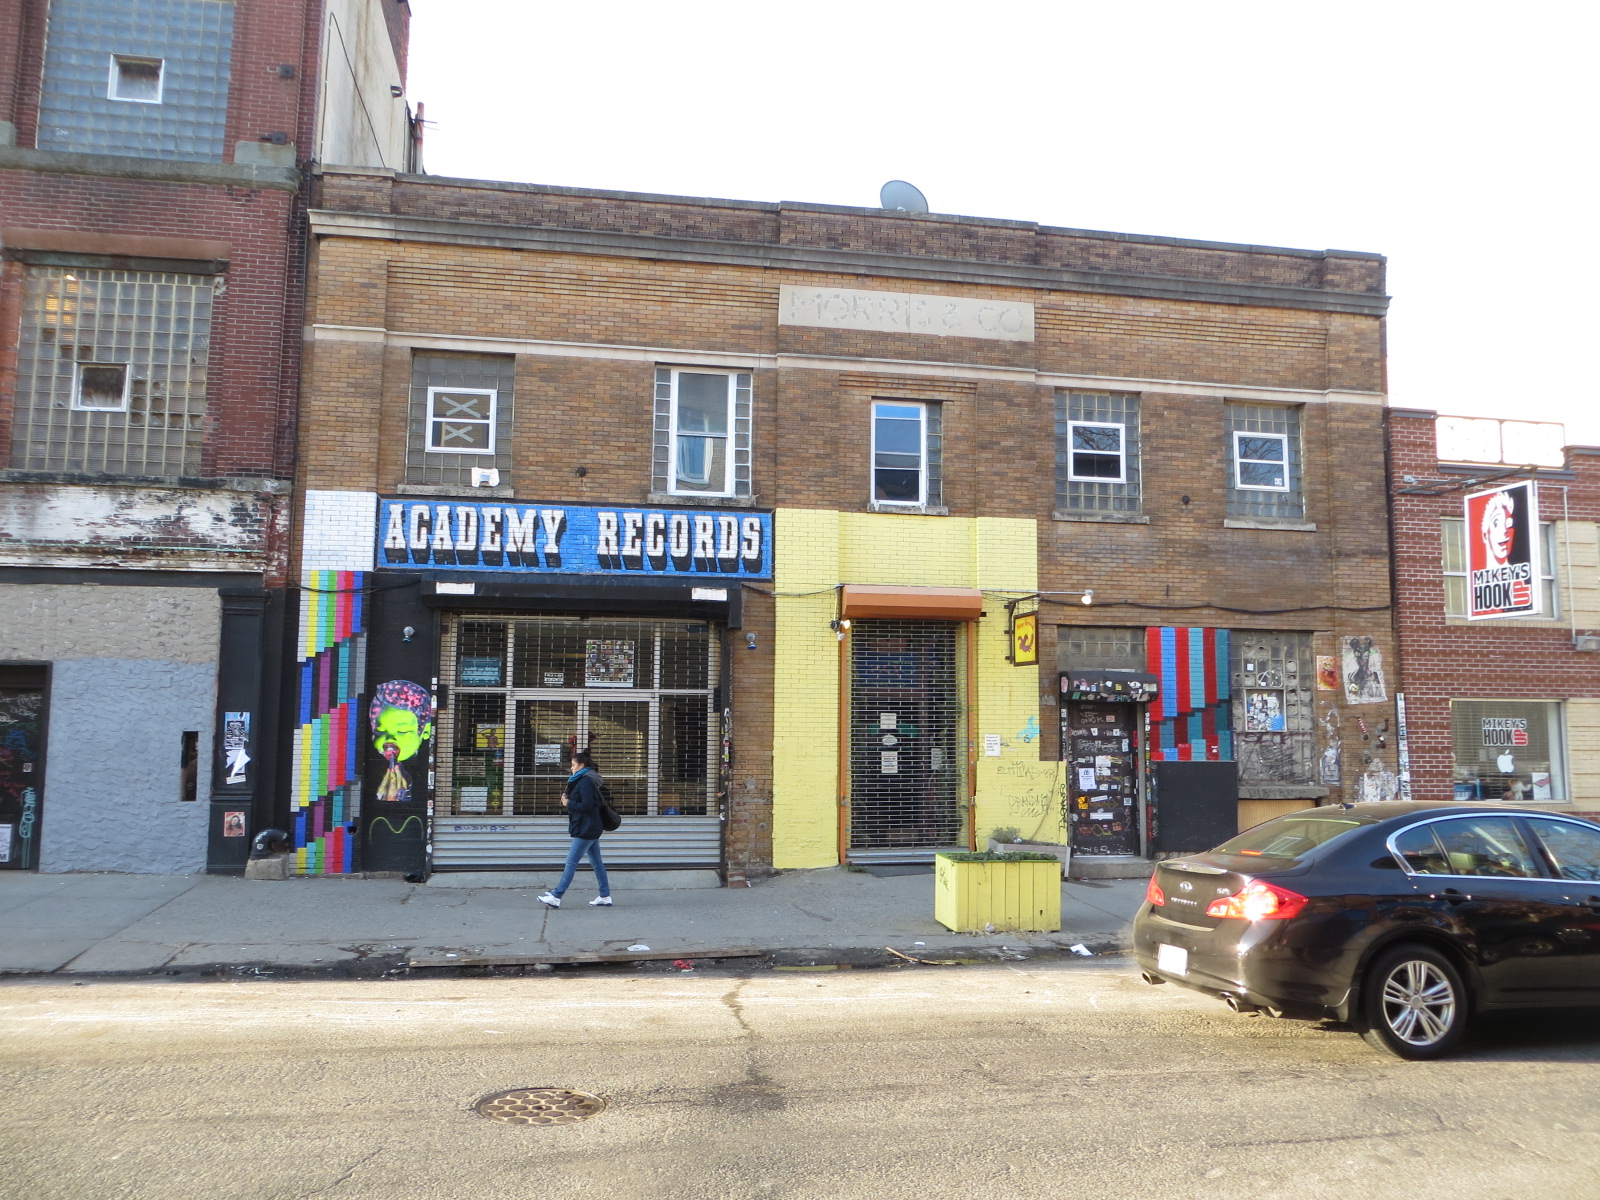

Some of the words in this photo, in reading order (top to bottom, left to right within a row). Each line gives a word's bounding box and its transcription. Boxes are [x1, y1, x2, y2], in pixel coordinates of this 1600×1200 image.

[791, 291, 930, 328] MORRIS
[942, 303, 962, 329] &
[976, 306, 1024, 332] CO
[384, 503, 566, 564] ACADEMY
[597, 511, 763, 568] RECORDS
[1473, 563, 1530, 585] MIKEY'S
[1475, 583, 1512, 610] HOOK
[1513, 581, 1531, 606] UP
[1482, 718, 1527, 729] MIKEY'S
[1483, 729, 1513, 745] HOOK
[1513, 729, 1528, 746] UP
